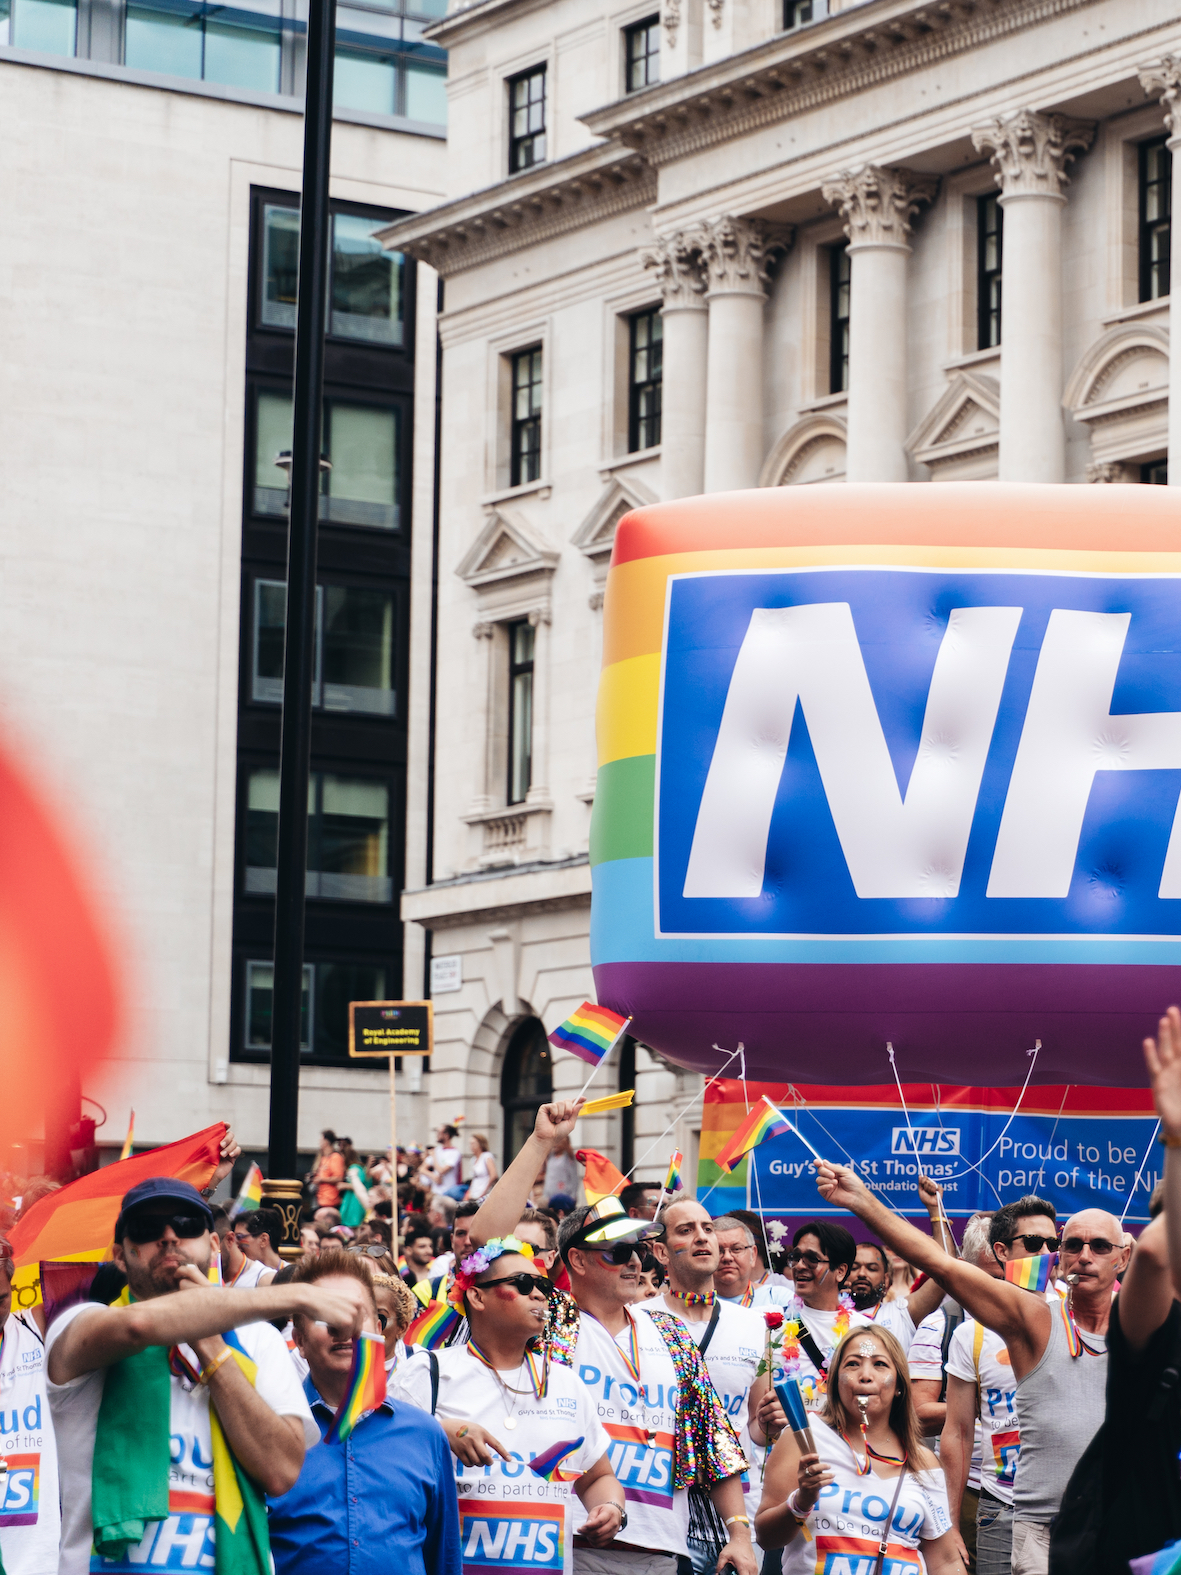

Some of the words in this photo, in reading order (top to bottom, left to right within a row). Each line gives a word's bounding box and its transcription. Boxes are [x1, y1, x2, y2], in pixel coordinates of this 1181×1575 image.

[363, 1028, 385, 1037] Royal
[386, 1028, 420, 1037] Academy
[364, 1037, 373, 1045] of
[374, 1037, 420, 1046] Engineering
[894, 1130, 957, 1153] NHS
[1000, 1136, 1068, 1161] Proud
[1077, 1142, 1100, 1163] to
[1108, 1141, 1136, 1164] be
[769, 1159, 816, 1178] Guy's
[861, 1159, 878, 1175] St
[865, 1180, 918, 1191] oundatio
[998, 1166, 1046, 1192] part
[1054, 1166, 1080, 1188] of
[1087, 1168, 1125, 1192] the
[597, 1403, 615, 1417] be
[651, 1411, 664, 1426] of
[1004, 1416, 1019, 1428] be
[6, 1435, 20, 1450] of
[25, 1434, 43, 1447] the
[169, 1470, 197, 1487] art
[457, 1482, 472, 1494] to
[477, 1480, 496, 1495] be
[502, 1483, 532, 1498] part
[537, 1482, 550, 1496] of
[553, 1484, 568, 1499] the
[813, 1482, 925, 1540] Prou
[815, 1516, 831, 1530] to
[836, 1516, 855, 1532] be
[463, 1520, 558, 1562] NHS
